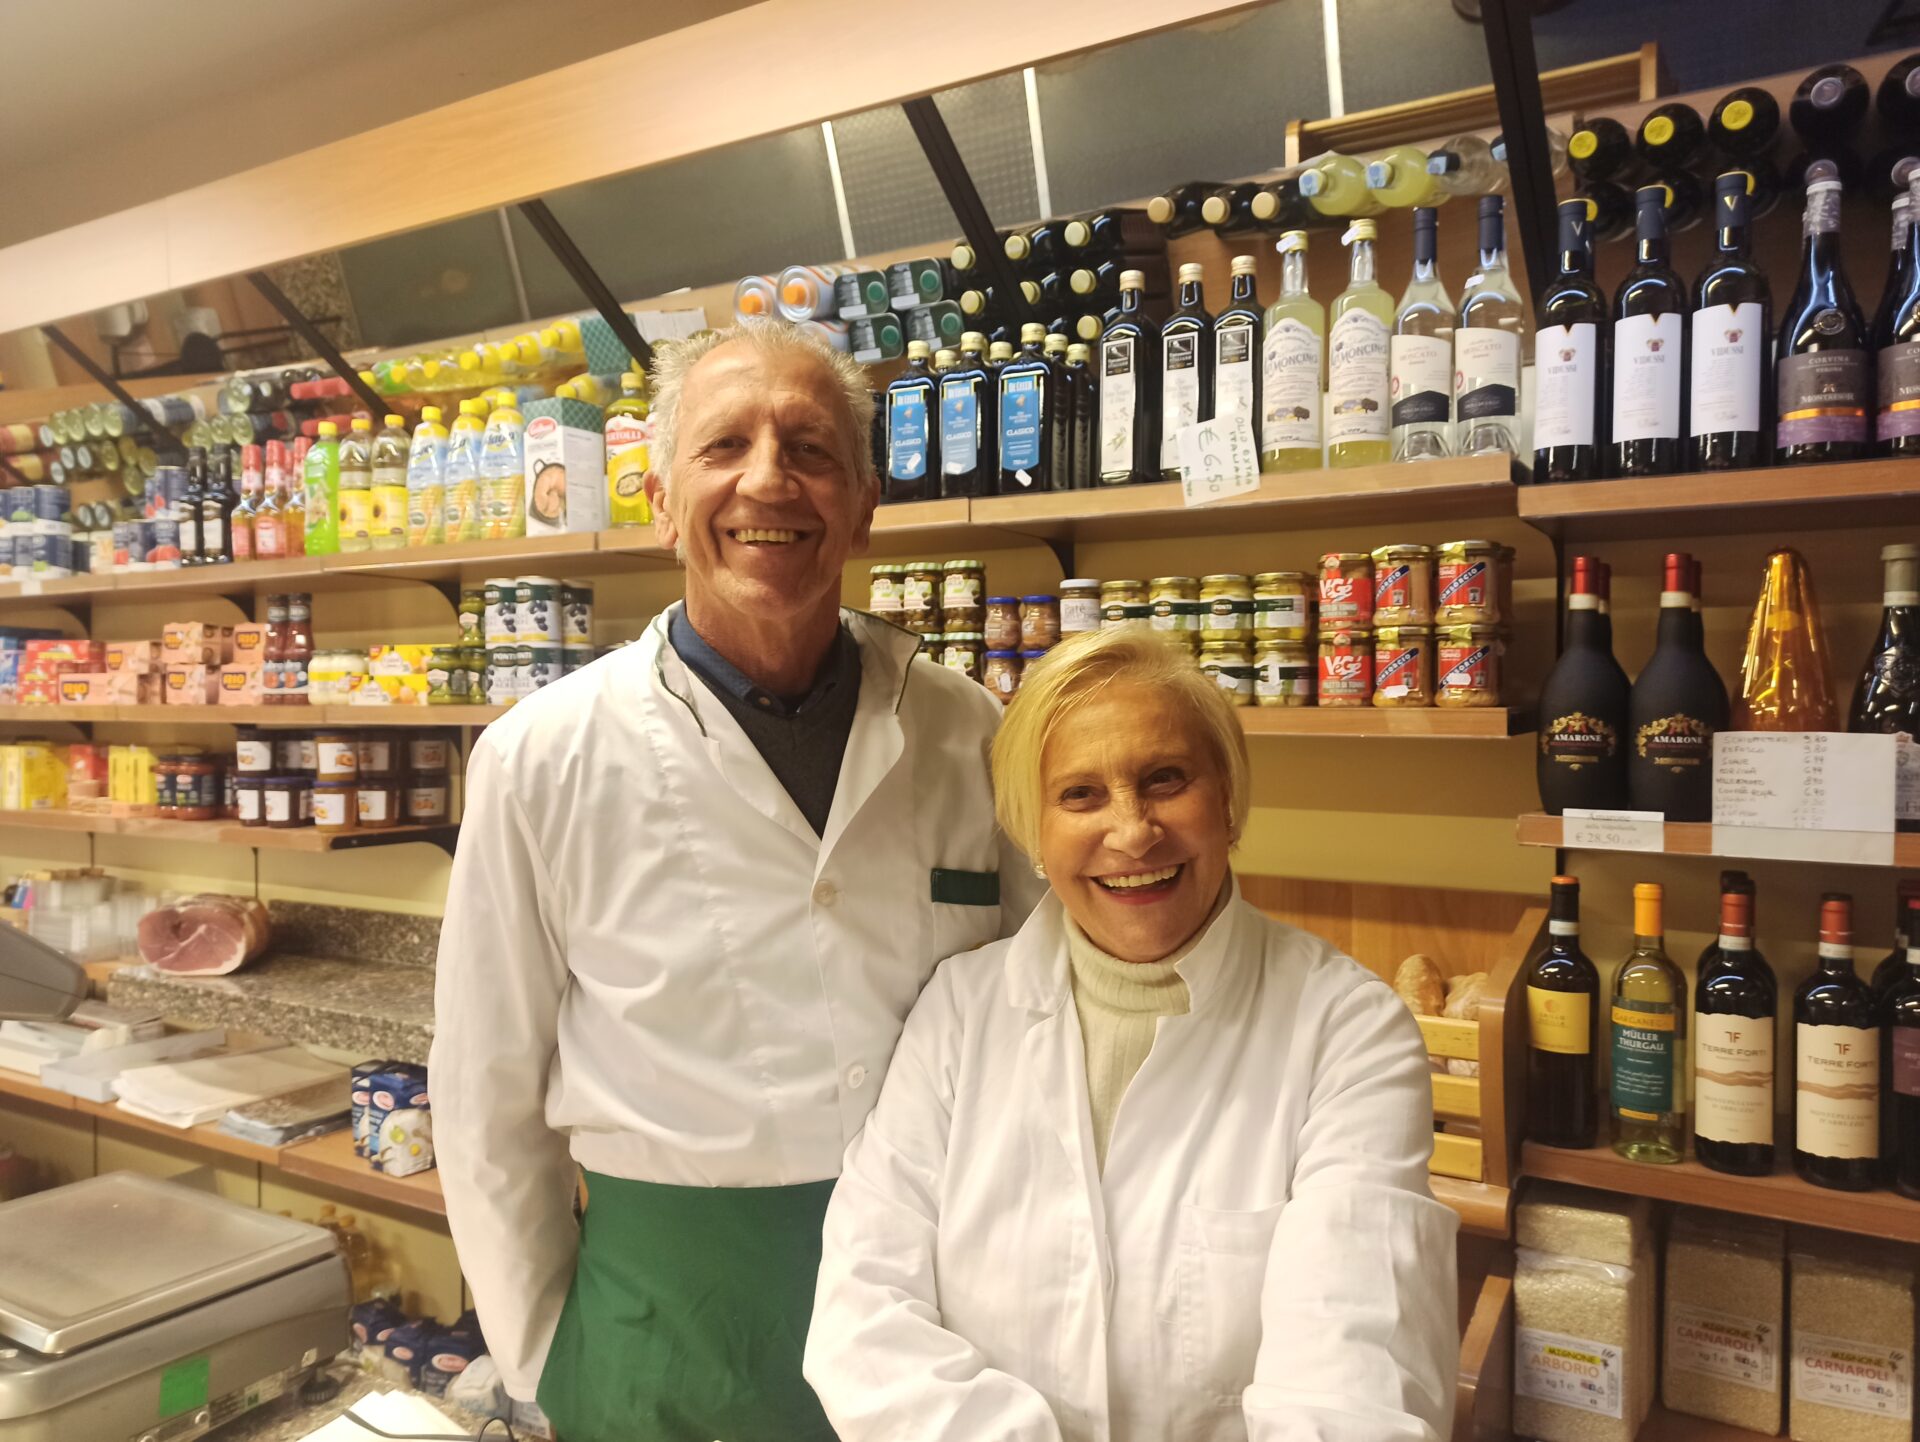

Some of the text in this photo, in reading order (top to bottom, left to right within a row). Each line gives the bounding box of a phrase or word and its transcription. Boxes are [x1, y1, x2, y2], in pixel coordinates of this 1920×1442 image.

[1808, 355, 1850, 365] CORVINA
[946, 431, 972, 441] CLASSICO
[1006, 426, 1035, 437] CLASSICO
[895, 437, 921, 447] CLASSICO
[1204, 454, 1223, 493] 6.50
[237, 633, 259, 643] RIO
[222, 673, 245, 684] RIO
[1553, 733, 1602, 742] AMARONE
[1652, 735, 1704, 744] AMARONE
[1575, 832, 1584, 842] €
[1622, 1028, 1659, 1041] MÜLLER
[1619, 1037, 1665, 1051] THURGAU
[1701, 1042, 1767, 1057] TERRE FORTI
[1807, 1055, 1844, 1068] TERRE
[1677, 1326, 1755, 1352] CARNAROLI
[1548, 1347, 1595, 1364] MIGNONE
[1830, 1351, 1885, 1368] MIGNONE
[1531, 1354, 1600, 1378] ARBORIO
[1804, 1357, 1888, 1382] CARNAROLI
